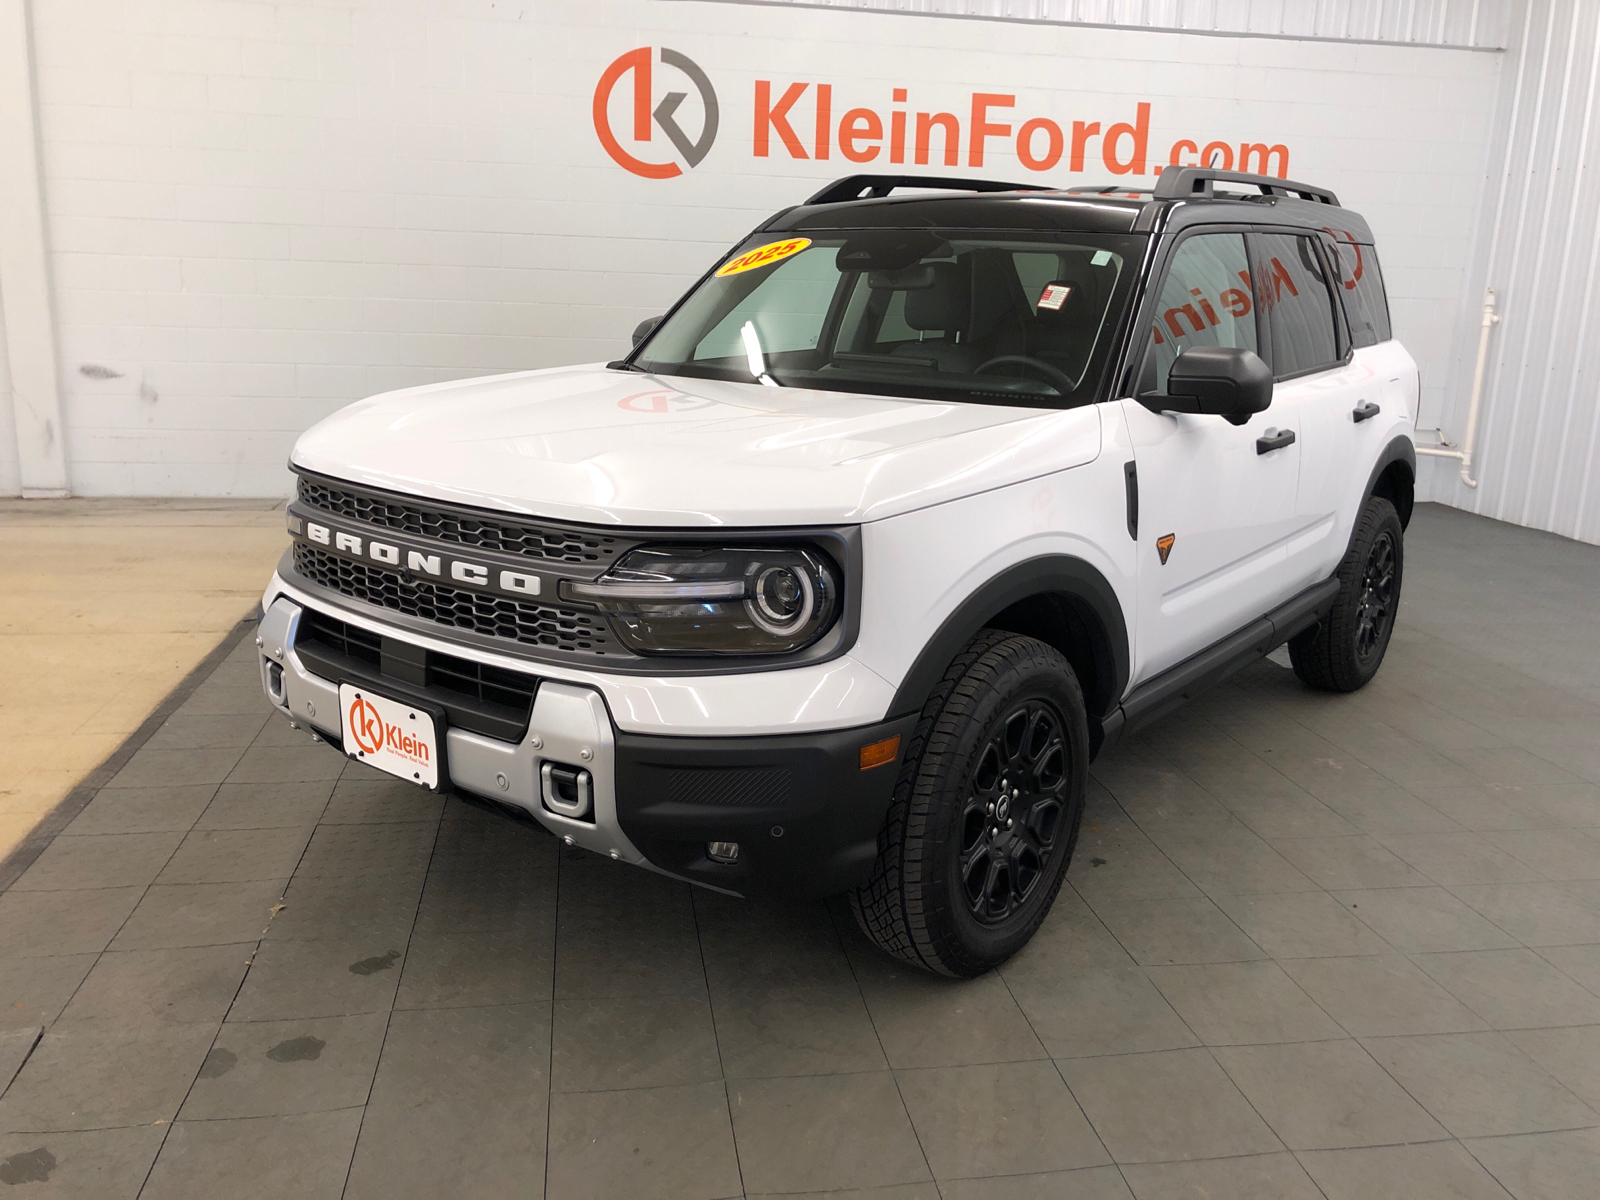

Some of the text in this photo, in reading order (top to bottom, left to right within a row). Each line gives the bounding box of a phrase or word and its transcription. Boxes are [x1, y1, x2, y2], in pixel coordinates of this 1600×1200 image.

[752, 79, 1290, 180] KleinFord.com
[722, 240, 802, 274] 2025
[306, 521, 542, 597] BRONCO
[385, 722, 429, 761] Klein
